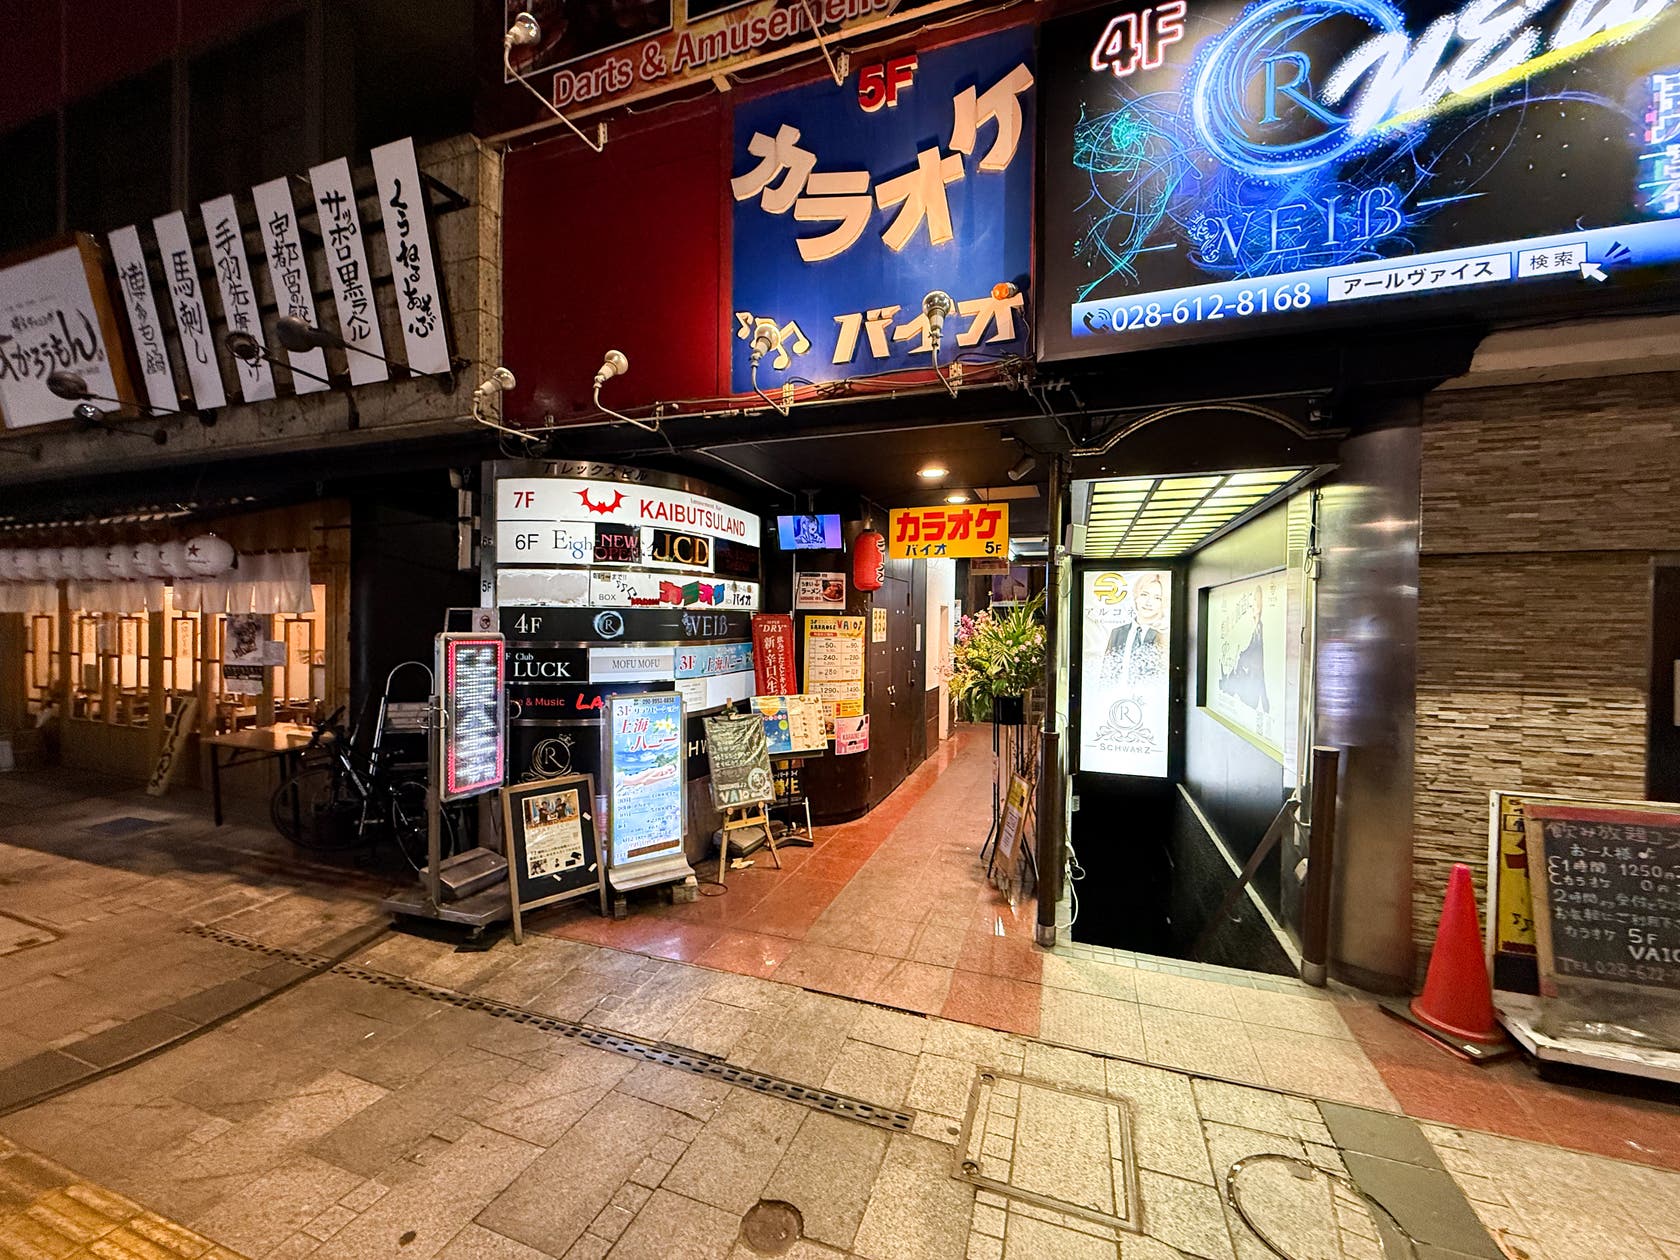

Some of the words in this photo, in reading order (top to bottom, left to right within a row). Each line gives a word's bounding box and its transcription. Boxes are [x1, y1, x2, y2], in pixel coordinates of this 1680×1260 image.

[1091, 0, 1186, 77] 4F
[554, 54, 632, 107] Darts
[639, 41, 668, 81] &
[672, 0, 888, 74] Amusemen
[858, 55, 919, 113] 5F
[731, 62, 1034, 263] カラオケ
[269, 211, 313, 324] 宇都宮の餃
[320, 190, 371, 342] サッポロ黒ラベル
[1529, 249, 1574, 271] 検索
[1344, 262, 1493, 295] アールヴァイス
[172, 251, 208, 364] 馬刺し
[1111, 282, 1312, 332] 028-612-8168
[832, 292, 1025, 365] バイオ
[513, 491, 535, 509] 7F
[640, 499, 746, 537] KAIBUTSULAND
[896, 508, 1002, 542] カラオケ
[515, 533, 539, 551] 6F
[601, 534, 638, 549] NEW
[906, 543, 947, 556] バイオ
[985, 541, 1002, 554] 5F
[598, 593, 617, 601] BOX
[514, 612, 542, 634] 4F
[515, 651, 534, 661] Club
[612, 658, 637, 670] MOFU
[638, 657, 661, 669] MOFU
[680, 655, 696, 670] 3F
[514, 661, 572, 678] LUCK
[526, 698, 534, 707] &
[535, 697, 566, 707] Music
[617, 705, 632, 717] 3F
[622, 718, 650, 734] 上海
[1100, 743, 1151, 754] SCHWARZ
[1628, 928, 1659, 945] 5F
